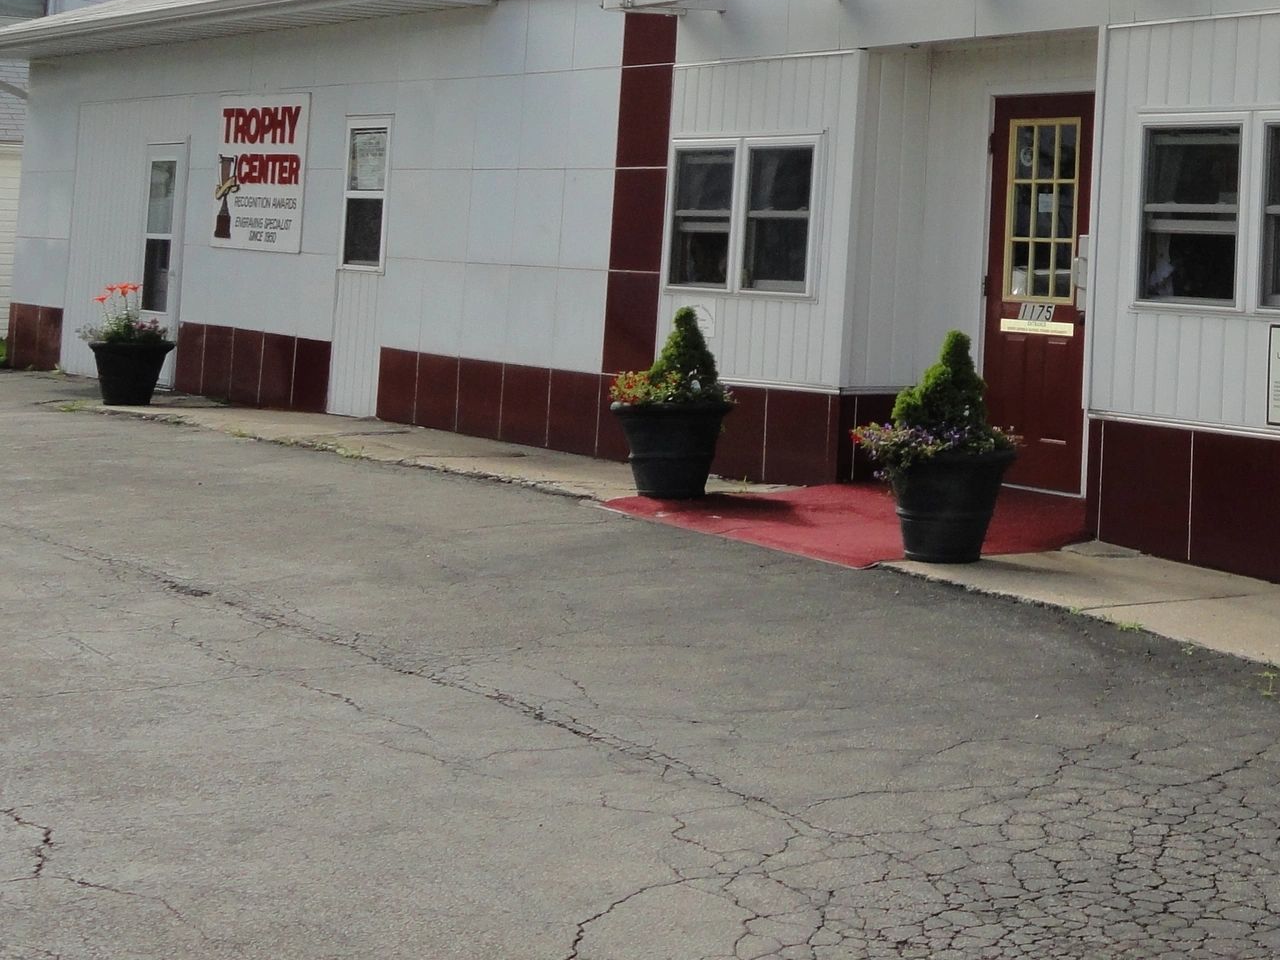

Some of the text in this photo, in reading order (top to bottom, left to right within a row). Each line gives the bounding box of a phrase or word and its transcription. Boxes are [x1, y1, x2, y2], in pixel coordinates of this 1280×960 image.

[223, 106, 301, 144] TROPHY
[237, 154, 301, 185] CENTER
[234, 196, 297, 210] RECOGNITION AWARDS
[264, 217, 292, 231] SPECIALIST
[248, 230, 263, 242] SINCE
[1021, 303, 1053, 321] 1175
